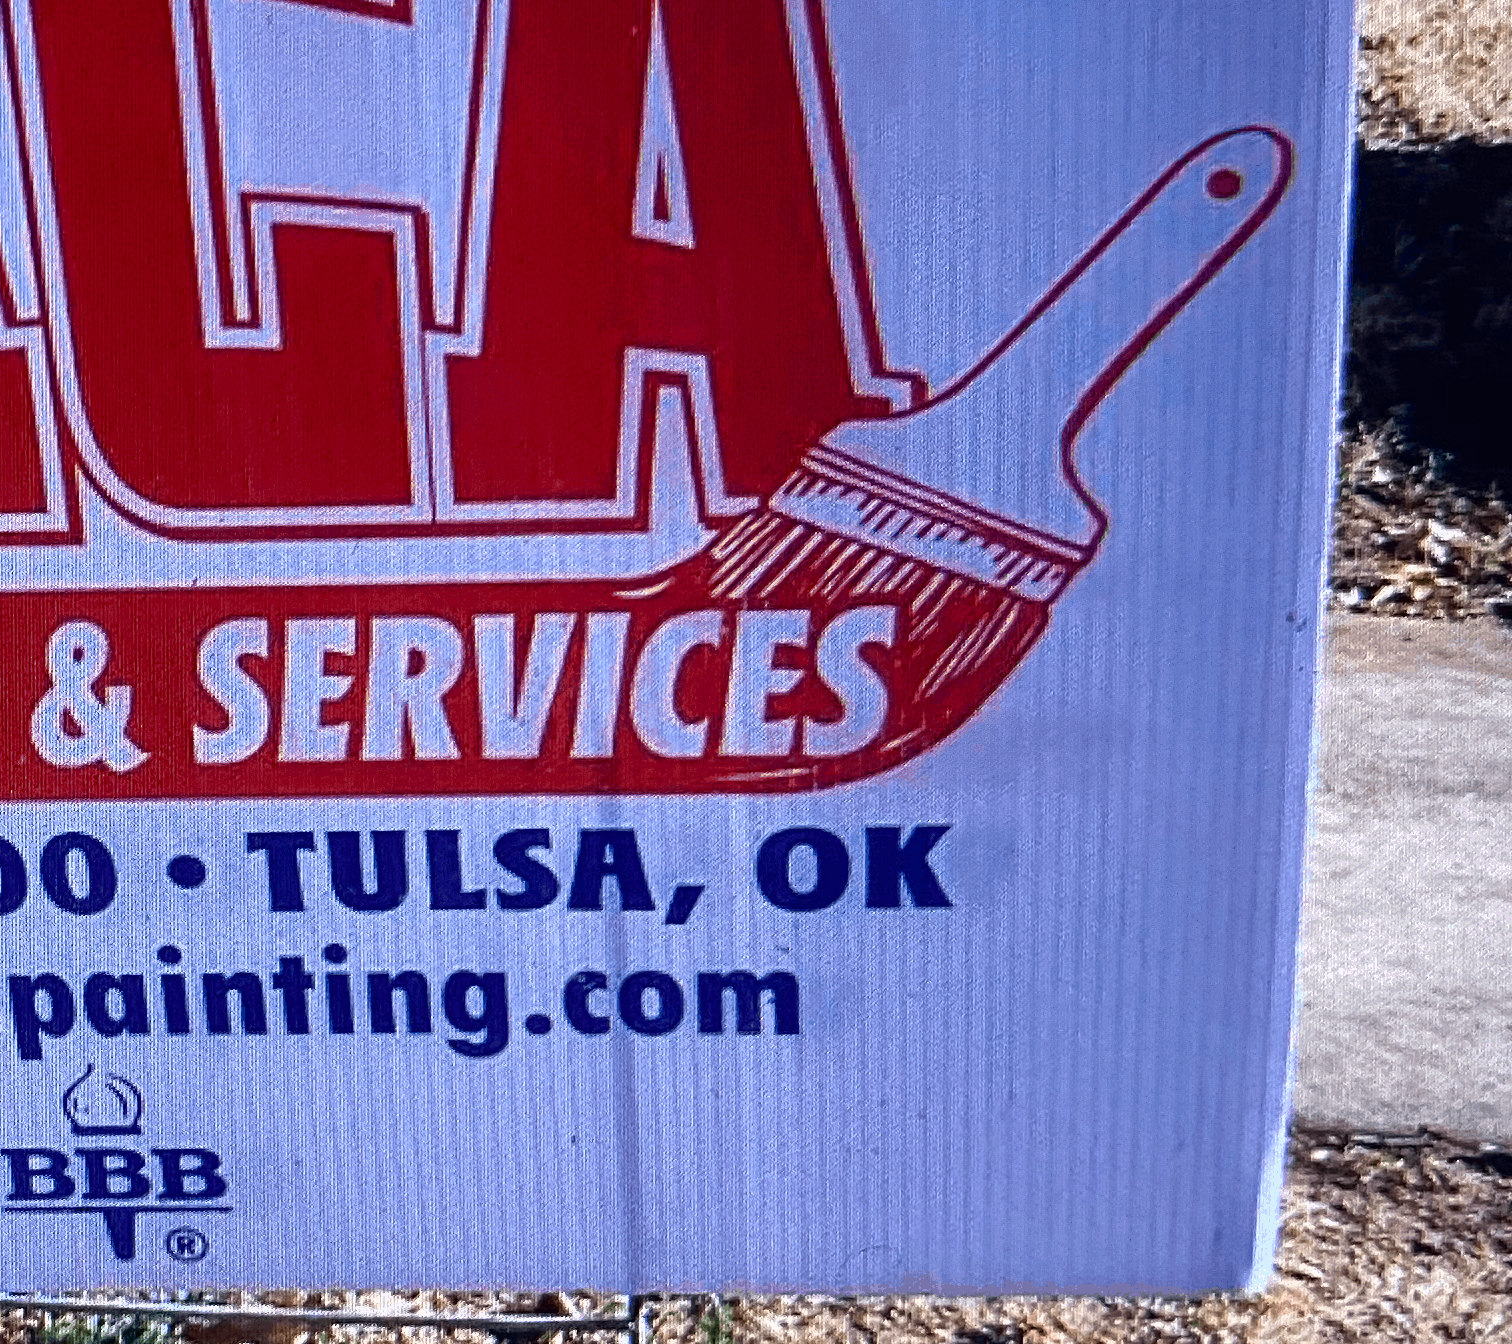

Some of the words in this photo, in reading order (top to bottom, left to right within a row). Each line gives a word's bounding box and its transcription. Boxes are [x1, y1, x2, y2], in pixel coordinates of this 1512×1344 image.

[30, 618, 151, 774] &
[192, 604, 900, 767] SERVICES
[245, 826, 706, 925] TULSA,
[755, 822, 954, 912] OK
[1, 1146, 229, 1202] BBB
